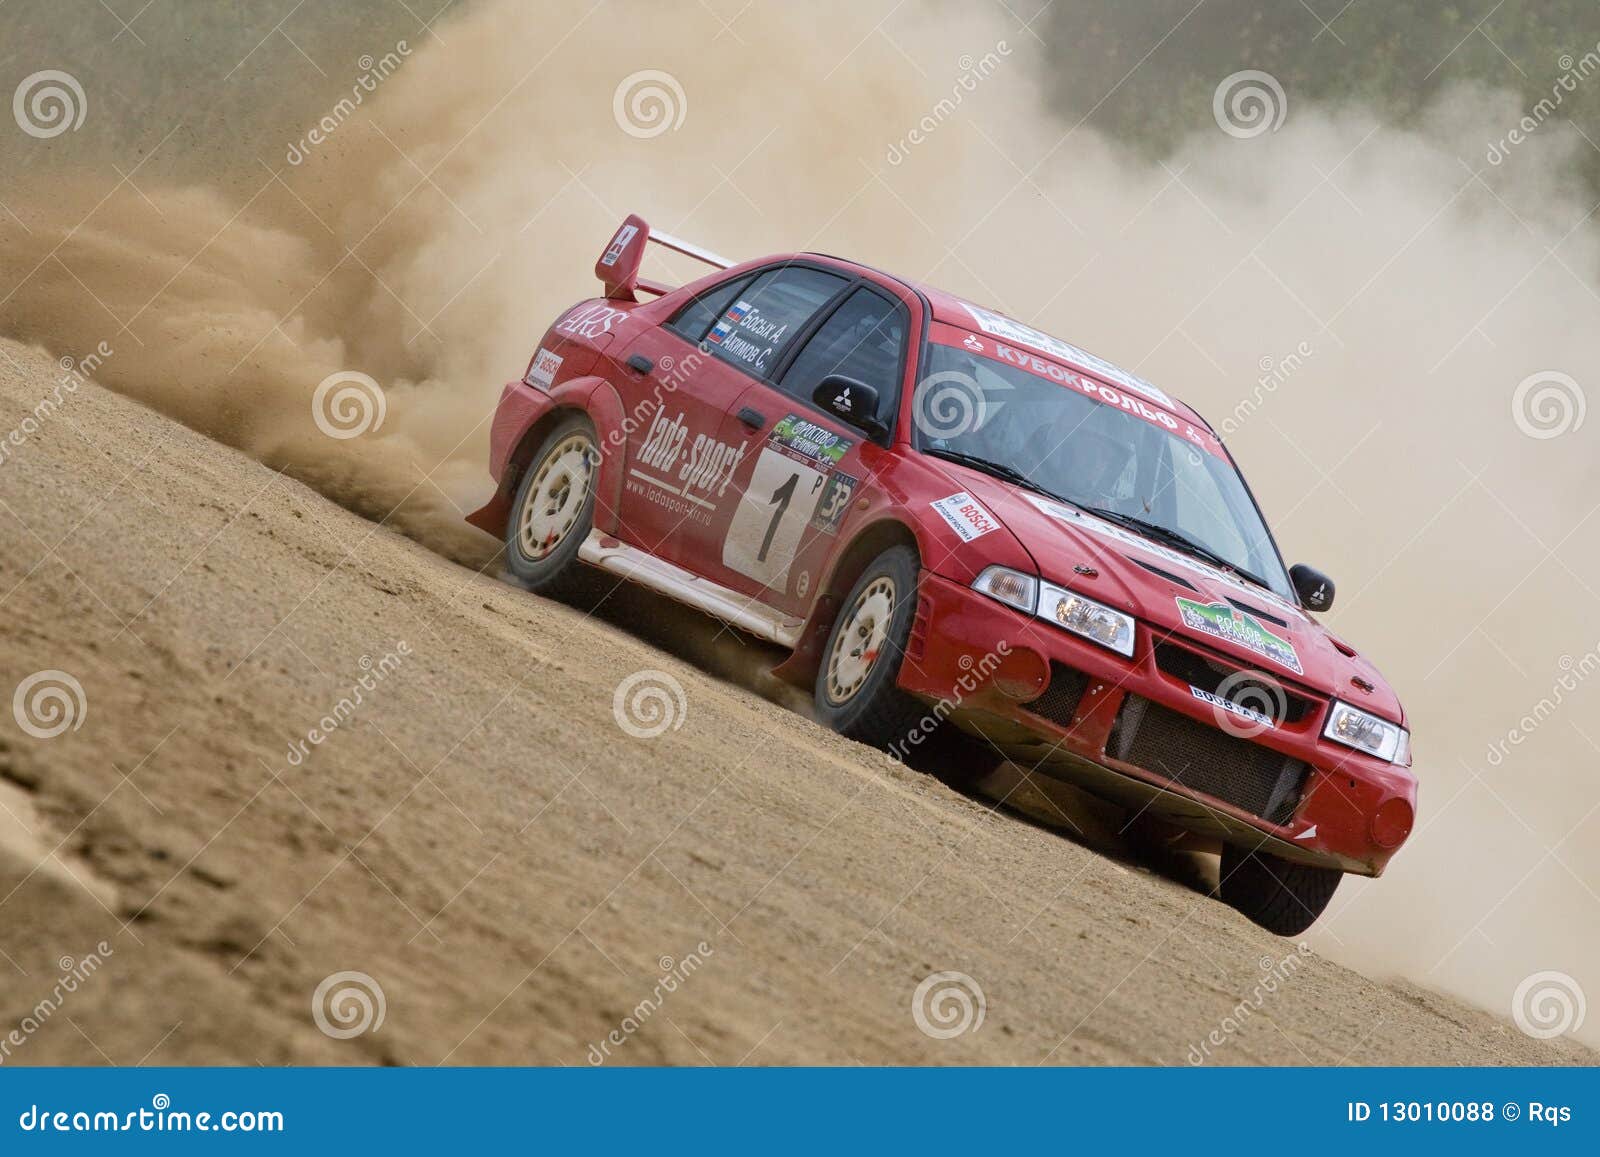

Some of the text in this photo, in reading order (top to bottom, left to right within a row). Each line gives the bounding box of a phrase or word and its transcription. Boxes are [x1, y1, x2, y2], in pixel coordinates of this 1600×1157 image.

[556, 305, 631, 339] ARS
[757, 472, 800, 562] 1
[960, 504, 994, 533] BOSCH
